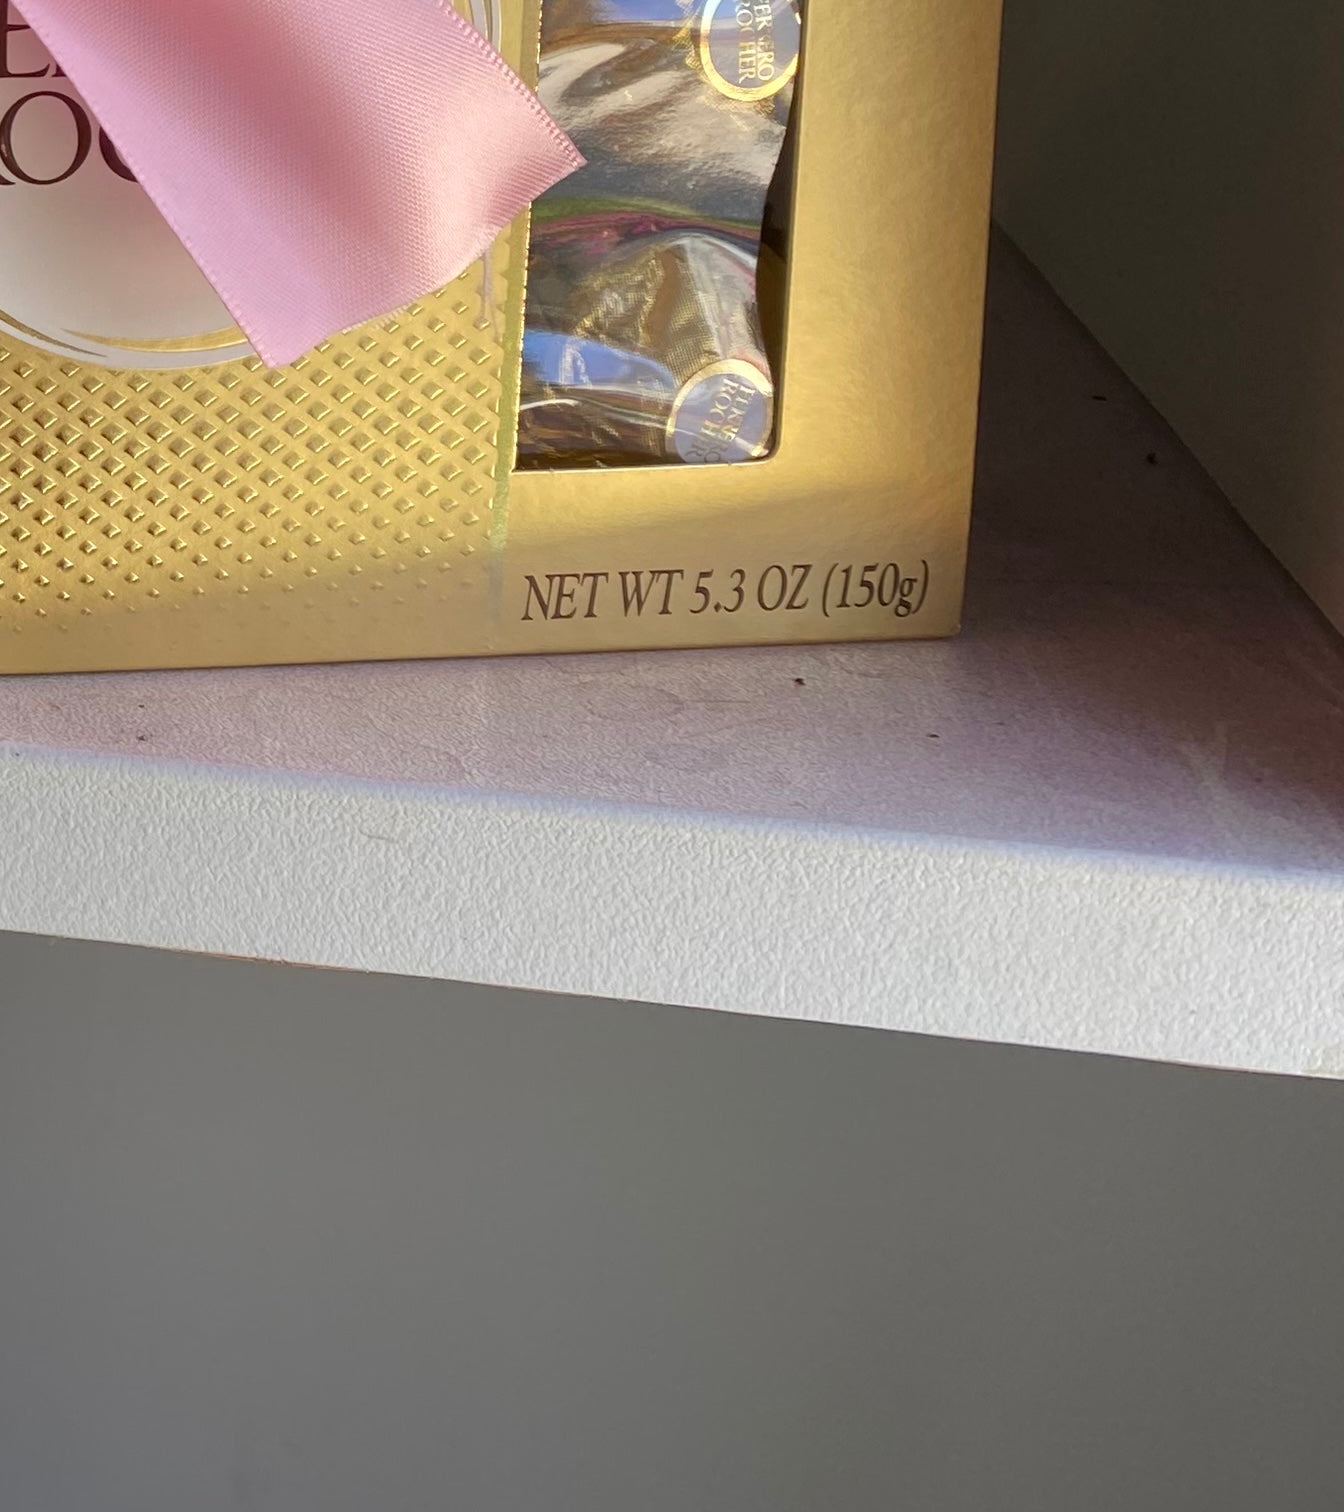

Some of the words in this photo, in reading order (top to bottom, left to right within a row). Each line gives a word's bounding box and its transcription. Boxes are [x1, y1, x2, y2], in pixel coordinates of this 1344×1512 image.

[521, 571, 609, 621] NET
[618, 569, 685, 617] WT
[689, 568, 746, 614] 5.3
[757, 564, 813, 612] OZ
[821, 560, 930, 618] (150g)
